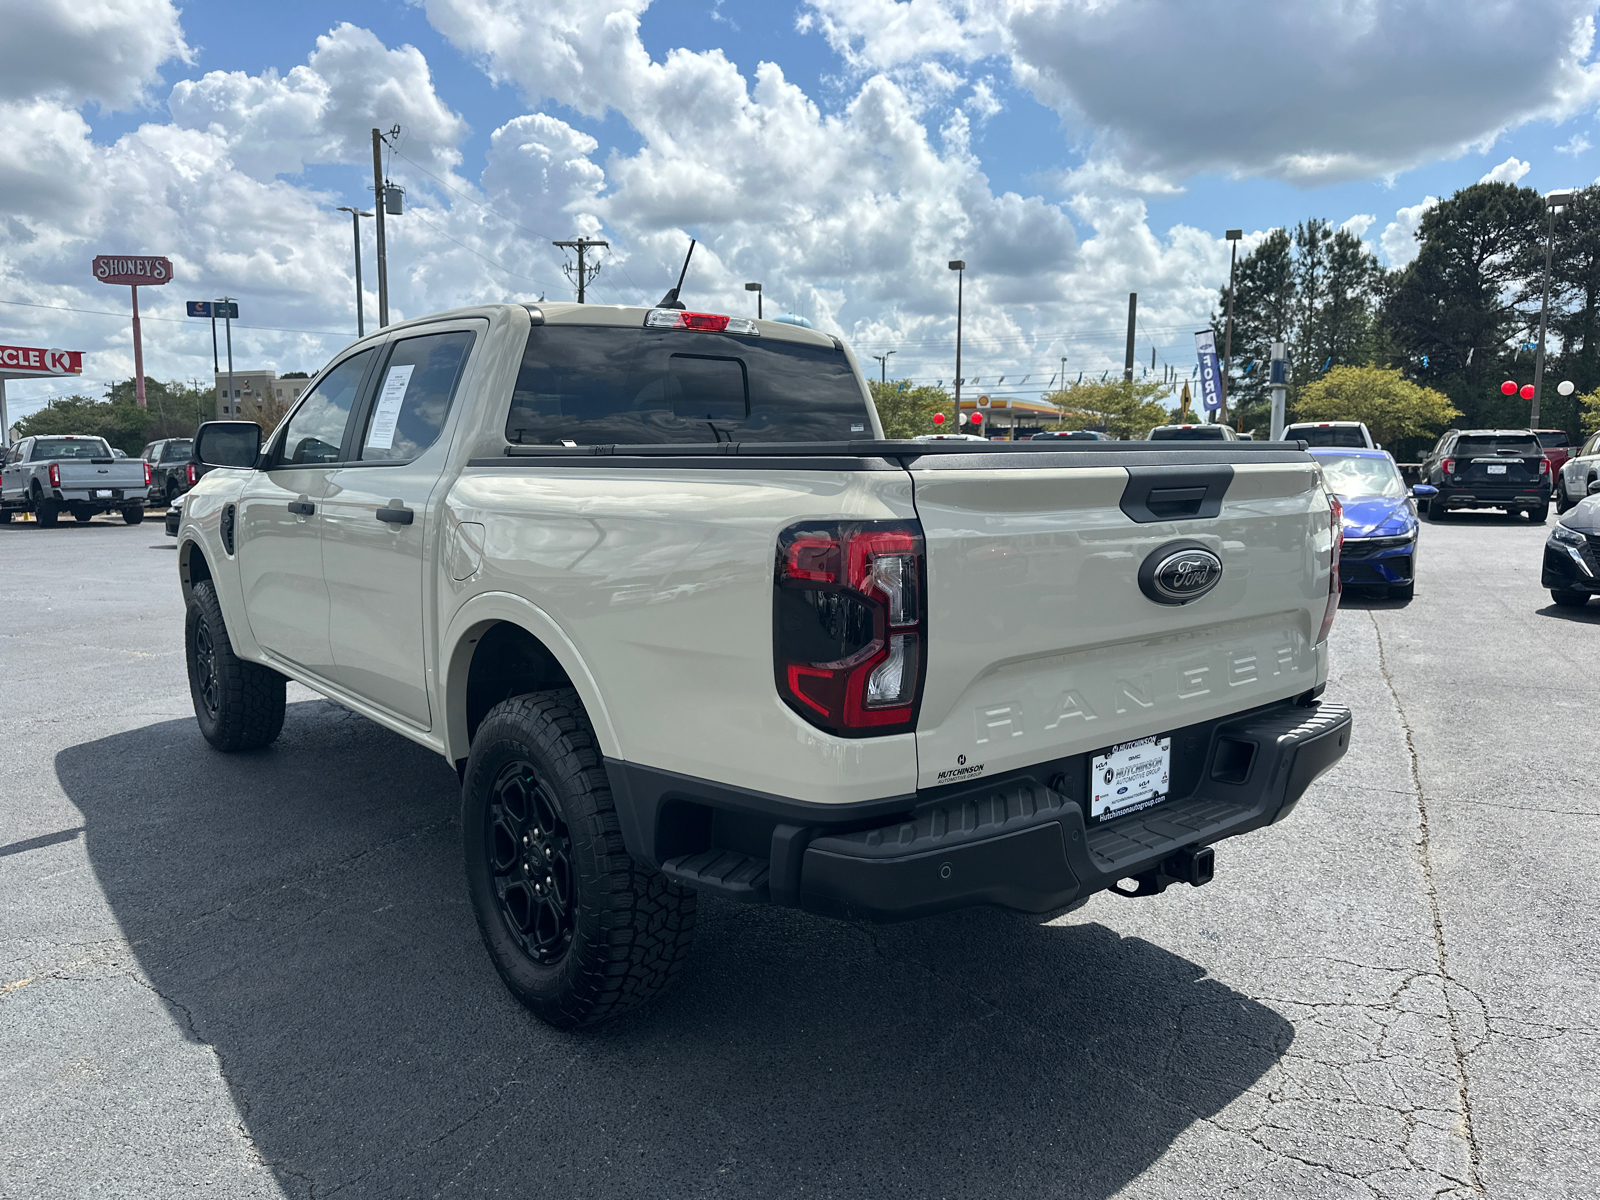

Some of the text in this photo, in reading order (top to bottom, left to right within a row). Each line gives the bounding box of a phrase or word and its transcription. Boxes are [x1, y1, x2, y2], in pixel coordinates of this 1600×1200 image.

[97, 259, 166, 279] SHONEY'S
[0, 349, 70, 373] CLE K
[1173, 561, 1209, 588] Ford
[974, 647, 1299, 744] RANGER
[938, 764, 984, 779] HUTCHINSON
[938, 771, 982, 784] AUTOMOTIVE GROUP
[1115, 757, 1163, 778] HUTCHINSON
[1116, 767, 1161, 785] AUTOMOTIVE GROUP
[1100, 796, 1166, 822] Hutchinsonautogroup.com
